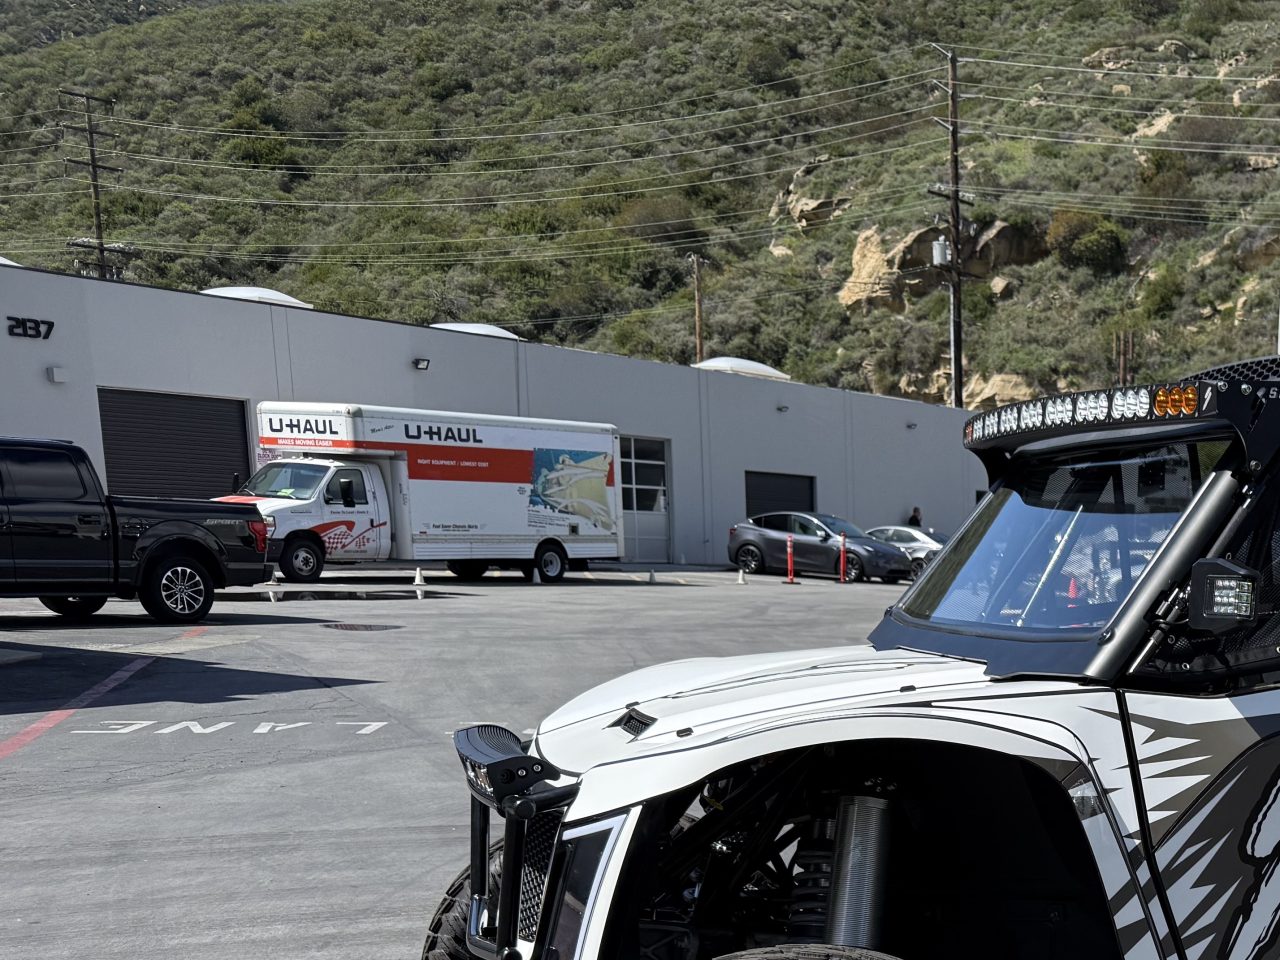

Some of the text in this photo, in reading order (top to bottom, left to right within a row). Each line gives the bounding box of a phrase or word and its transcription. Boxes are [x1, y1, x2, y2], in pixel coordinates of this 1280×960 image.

[7, 316, 55, 340] 2137
[268, 417, 339, 435] U-HAUL
[404, 423, 483, 443] U-HAUL
[277, 438, 295, 446] MAKES
[295, 439, 315, 447] MOVING
